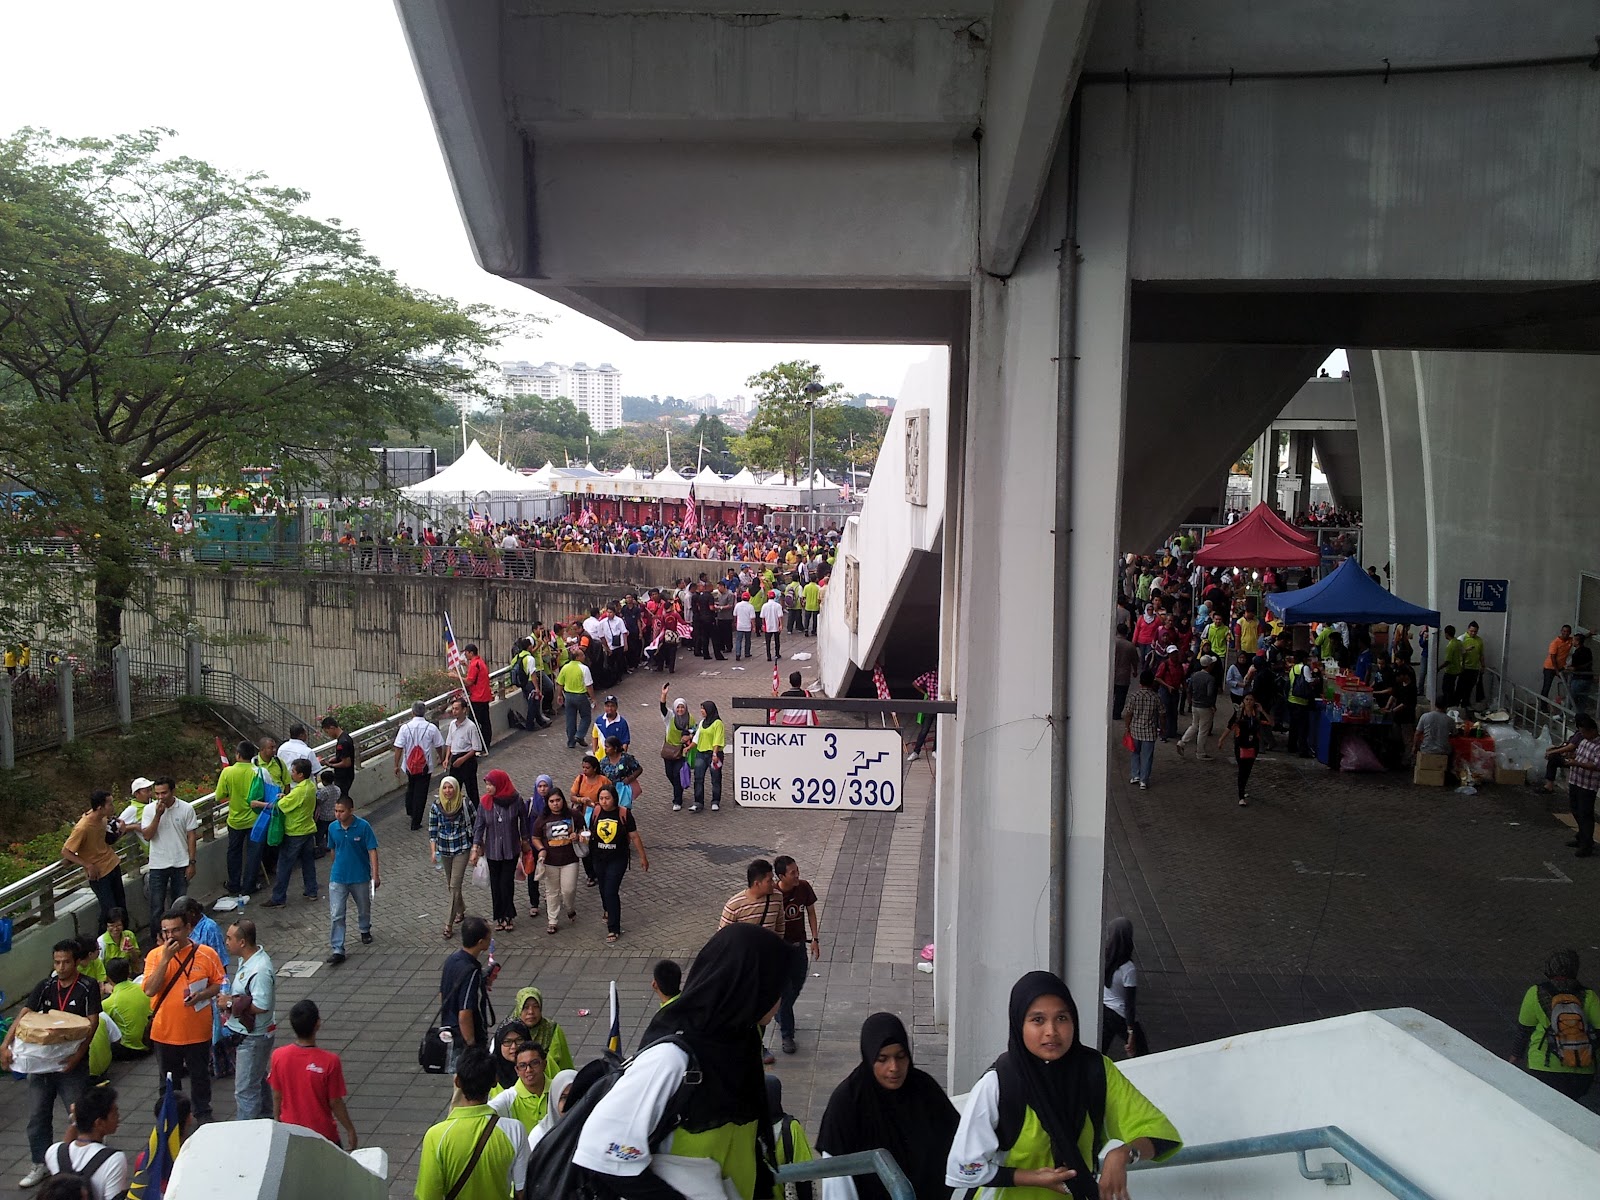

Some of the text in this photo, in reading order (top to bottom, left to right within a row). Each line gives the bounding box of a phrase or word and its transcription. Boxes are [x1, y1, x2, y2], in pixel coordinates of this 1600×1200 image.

[740, 732, 838, 760] TINGKAT 3
[740, 746, 767, 758] Tier
[741, 777, 895, 806] BLOK 329/330
[741, 791, 777, 801] Block
